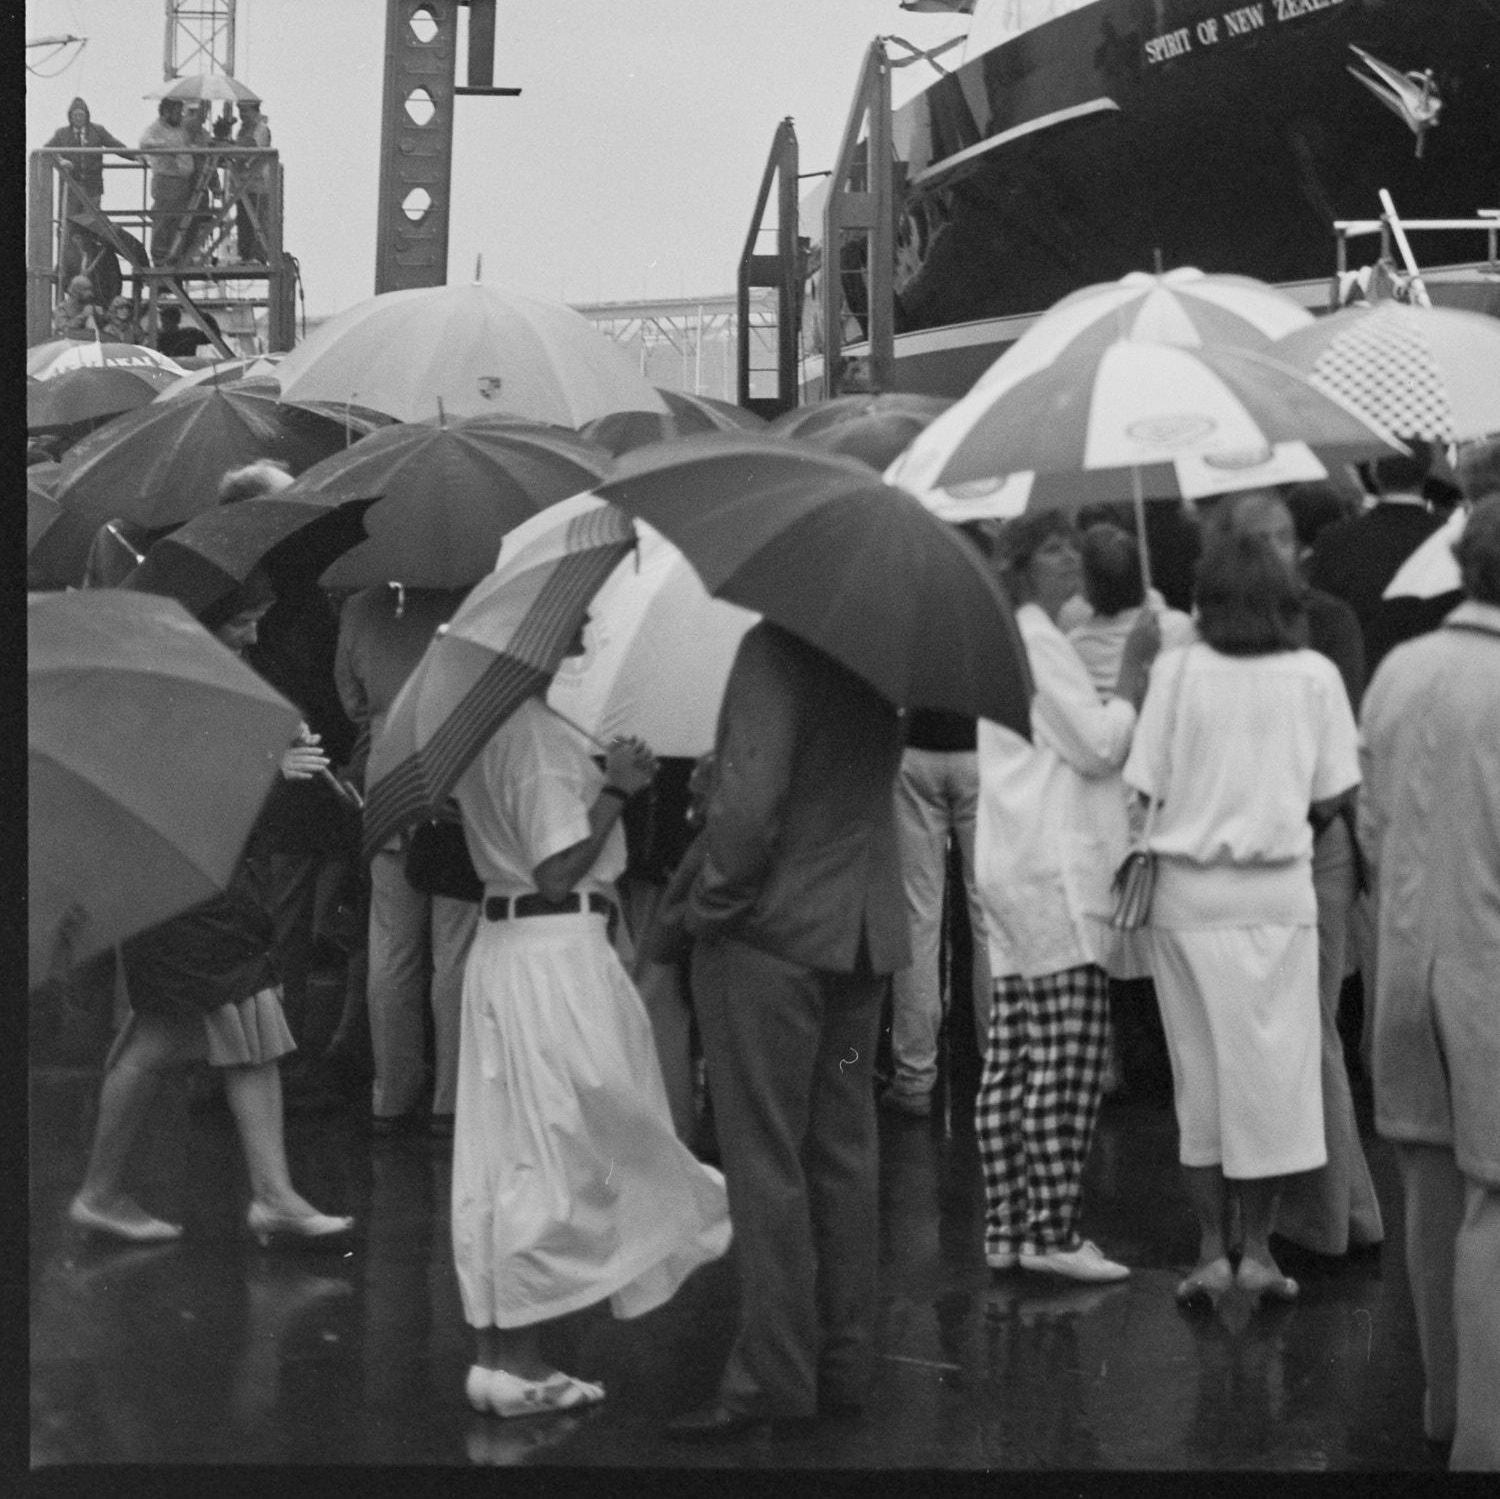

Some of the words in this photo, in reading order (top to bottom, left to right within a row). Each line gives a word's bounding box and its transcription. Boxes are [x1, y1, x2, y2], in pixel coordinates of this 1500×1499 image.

[1145, 28, 1191, 63] SPIRIT
[1197, 18, 1218, 45] OF
[1223, 4, 1264, 36] NEW
